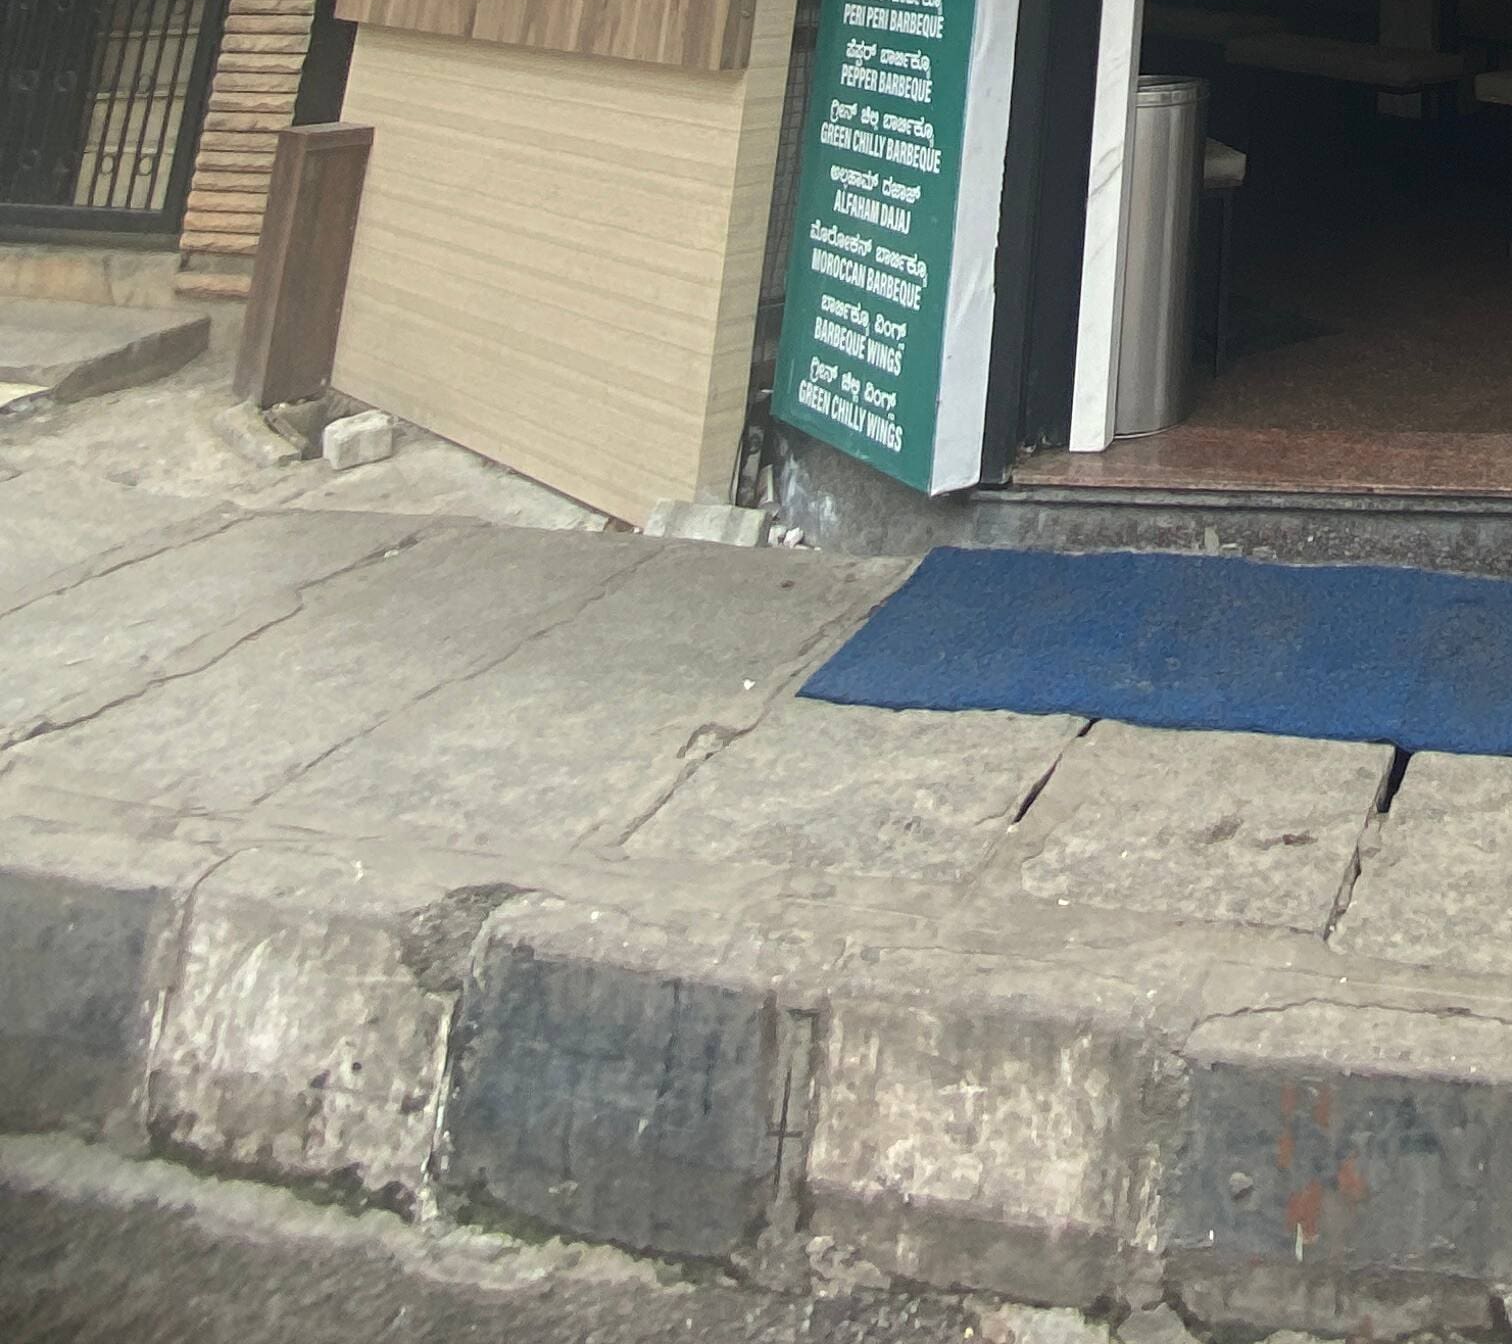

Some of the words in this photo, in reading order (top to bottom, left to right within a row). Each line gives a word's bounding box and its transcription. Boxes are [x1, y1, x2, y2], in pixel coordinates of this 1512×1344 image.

[843, 3, 866, 26] PERI
[866, 6, 889, 31] PERI
[889, 9, 945, 39] BARBEQUE
[840, 63, 878, 94] PEPPER
[878, 70, 933, 103] BARBEQUE
[820, 122, 852, 149] GREEN
[852, 127, 886, 159] CHILLY
[885, 136, 942, 174] BARBEQUE
[833, 189, 879, 225] ALFAHAM
[879, 204, 911, 235] DAJAJ
[811, 248, 867, 291] MOROCCAN
[866, 268, 922, 311] BARBEQUE
[814, 316, 867, 359] BARBEQUE
[867, 334, 903, 376] WINGS
[798, 379, 831, 415] GREEN
[830, 393, 866, 434] CHILLY
[865, 409, 903, 453] WINGS
